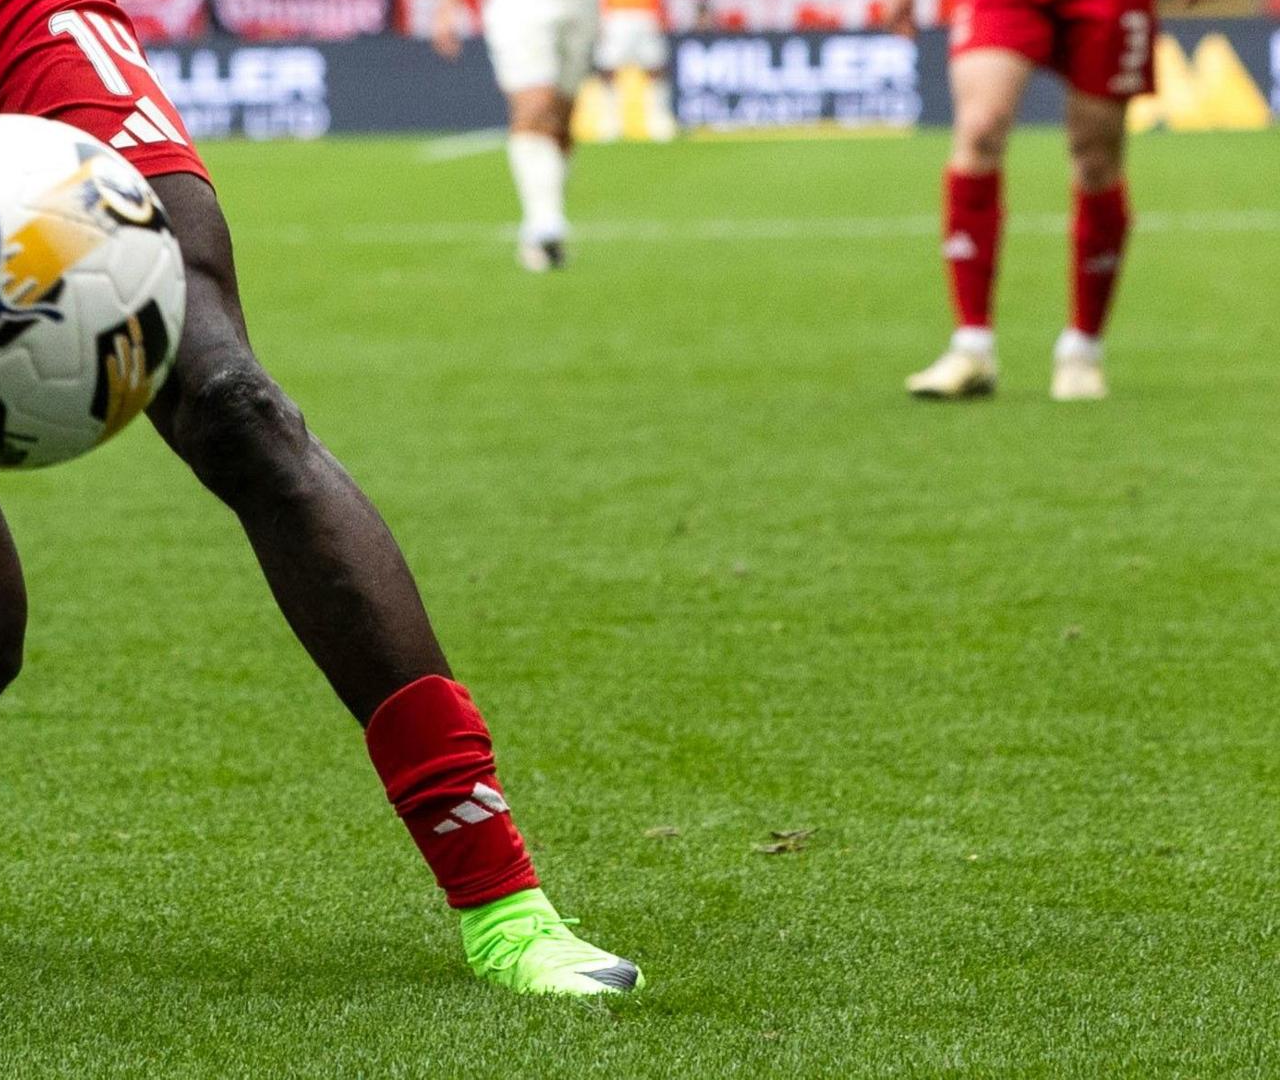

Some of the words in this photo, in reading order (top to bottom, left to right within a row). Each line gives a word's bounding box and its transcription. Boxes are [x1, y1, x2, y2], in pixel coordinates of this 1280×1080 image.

[48, 9, 177, 110] 14
[148, 45, 327, 104] LLER
[676, 34, 919, 92] MILLER
